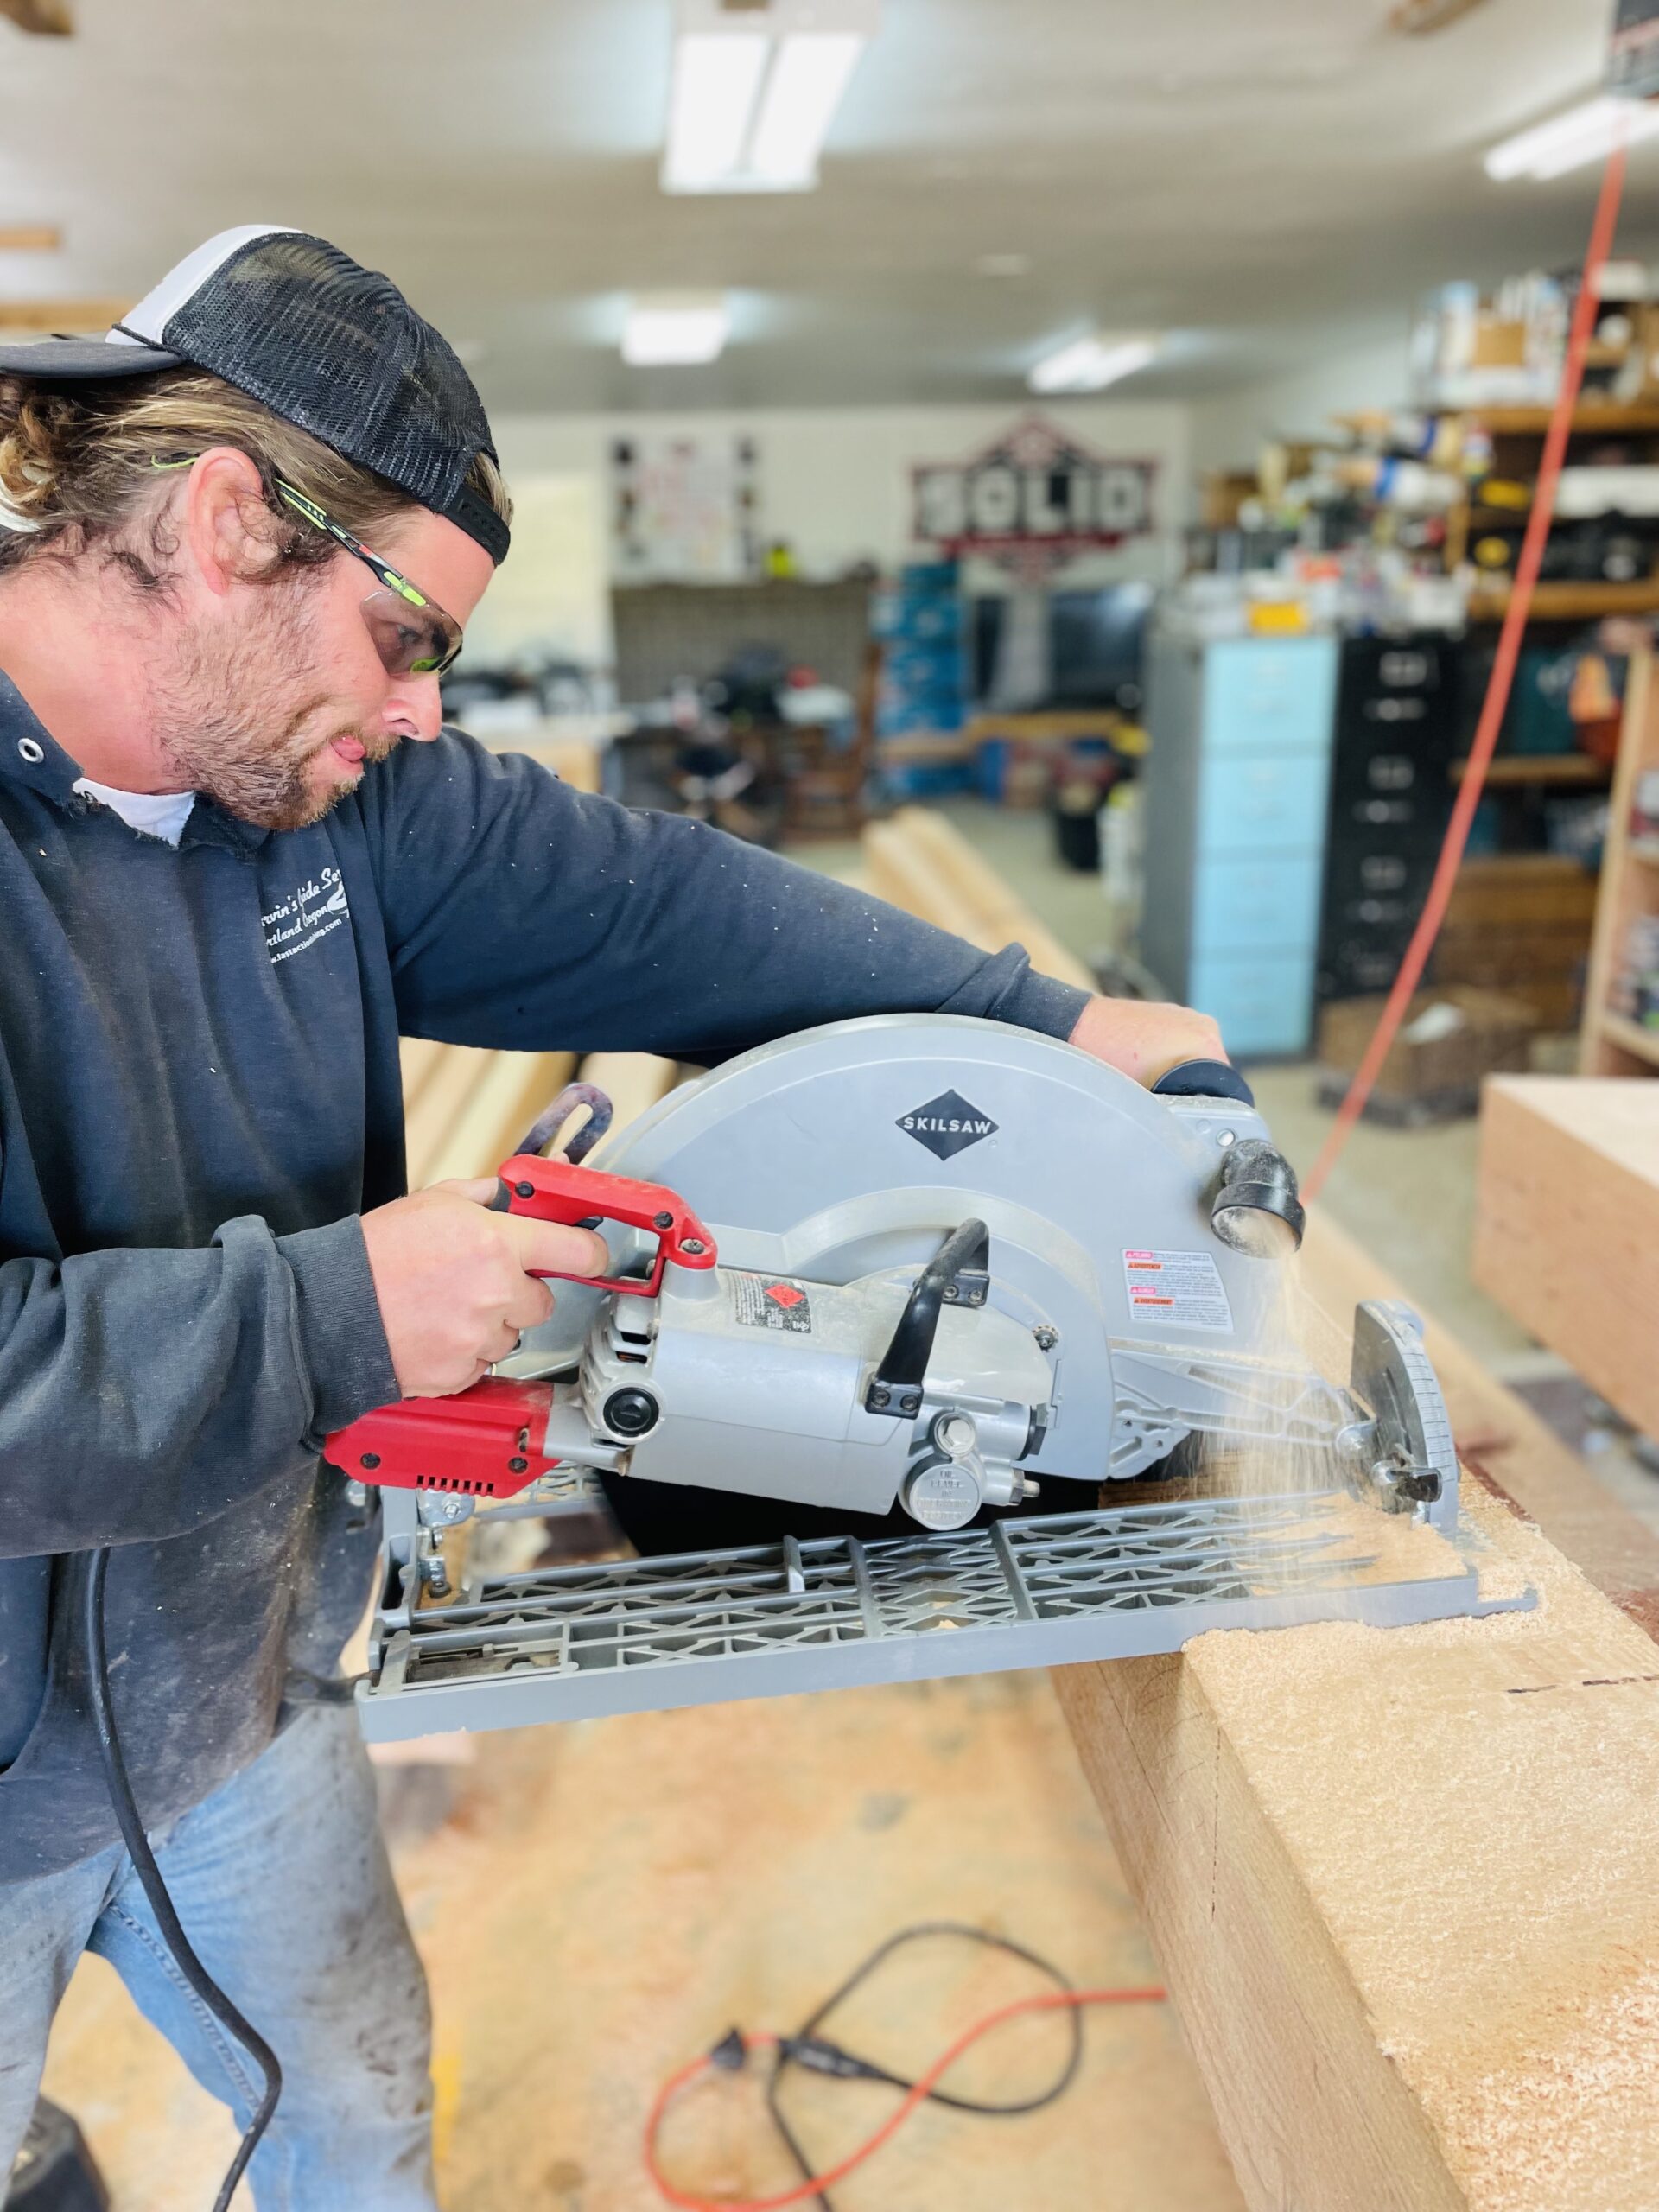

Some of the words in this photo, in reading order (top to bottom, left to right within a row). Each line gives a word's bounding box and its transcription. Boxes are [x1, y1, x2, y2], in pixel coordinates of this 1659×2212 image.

[920, 466, 1144, 536] SOLID
[261, 895, 298, 926] rvin's
[903, 1116, 991, 1134] SKILSAW
